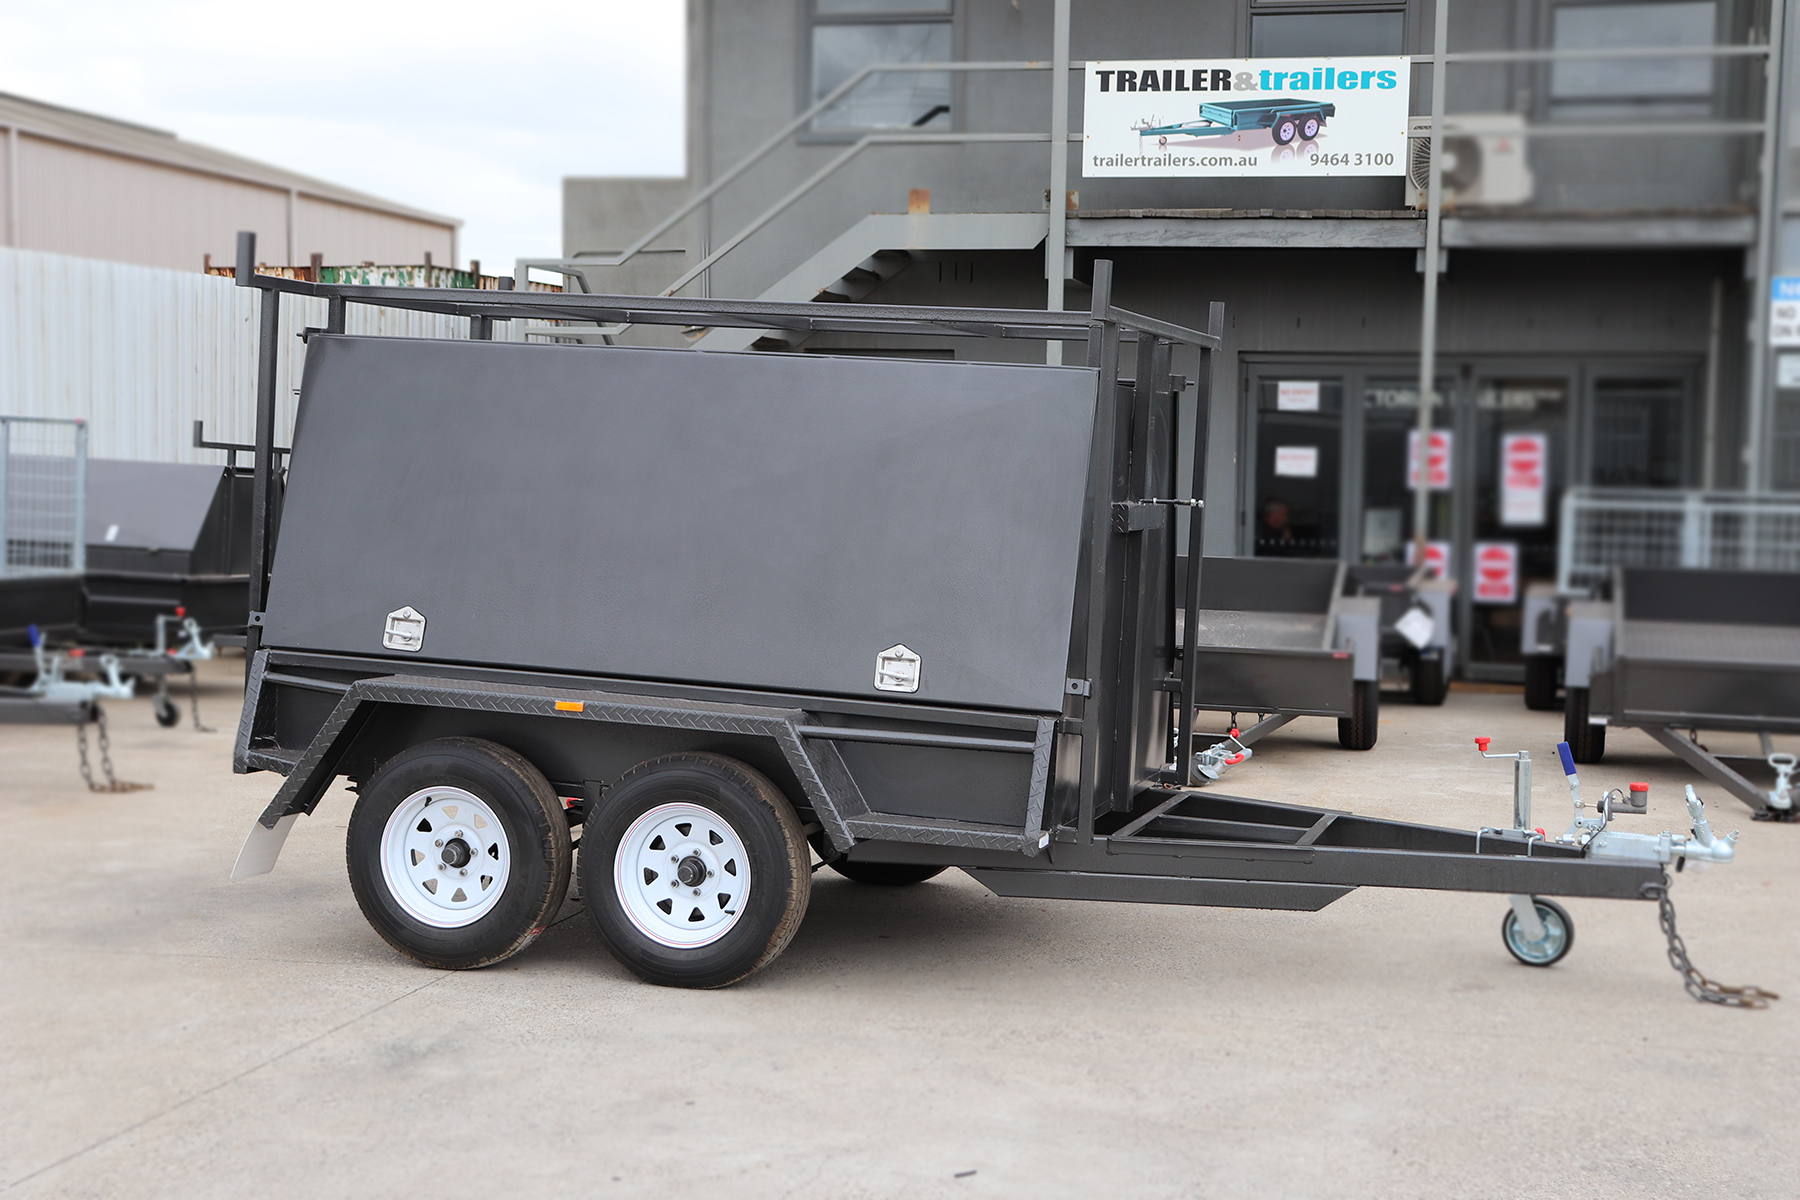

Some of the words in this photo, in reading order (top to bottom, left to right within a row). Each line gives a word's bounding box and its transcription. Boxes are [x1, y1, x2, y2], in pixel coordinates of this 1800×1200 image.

[1093, 153, 1257, 167] trailertrailers.com.au
[1310, 153, 1350, 166] 9464
[1353, 153, 1394, 166] 3100
